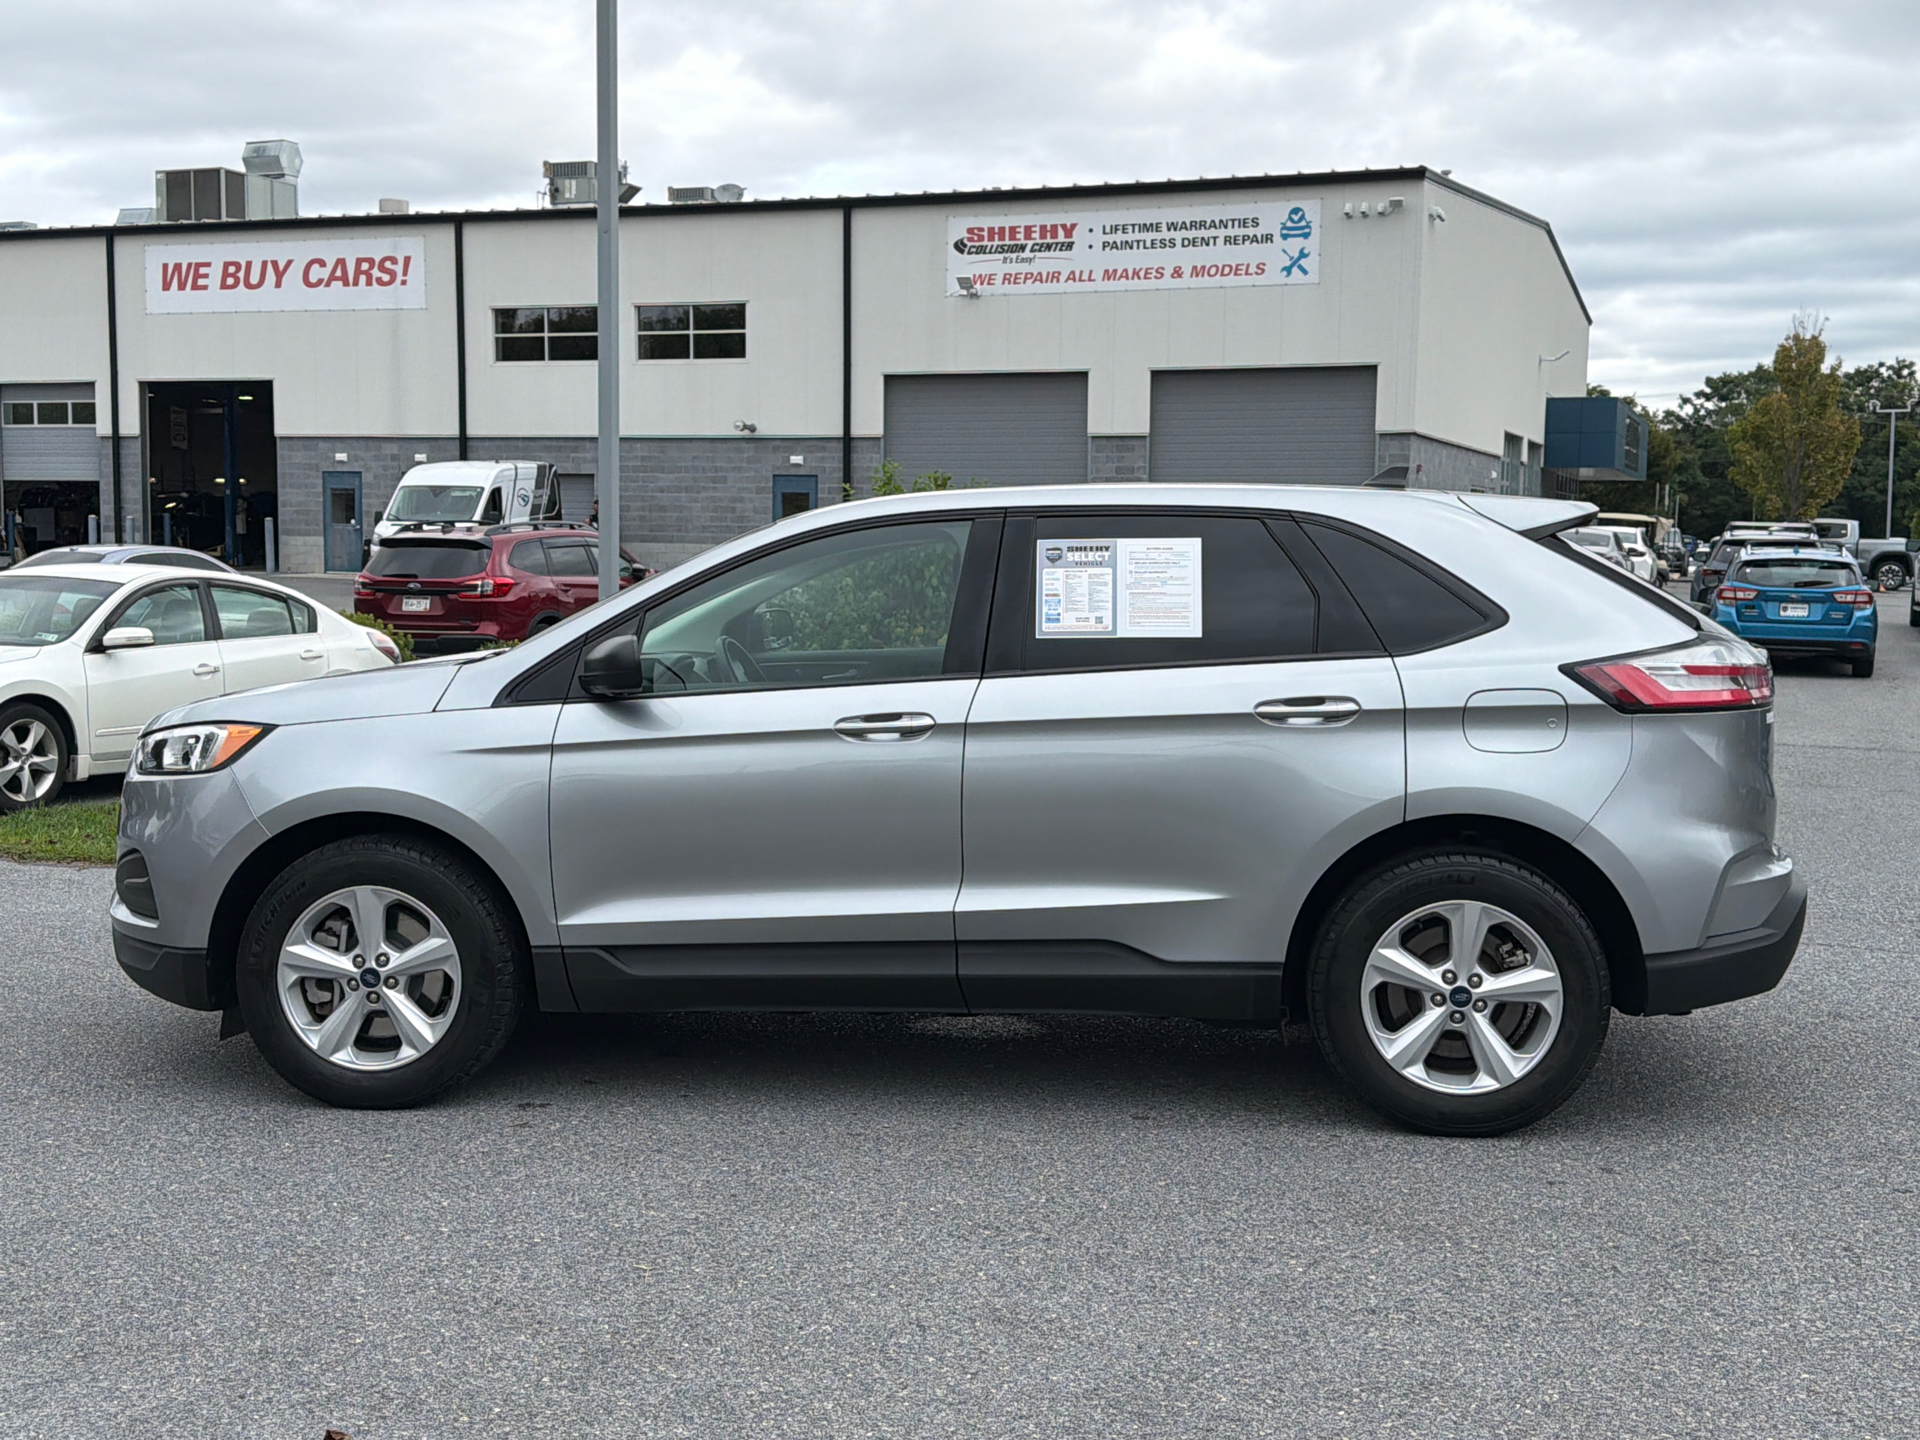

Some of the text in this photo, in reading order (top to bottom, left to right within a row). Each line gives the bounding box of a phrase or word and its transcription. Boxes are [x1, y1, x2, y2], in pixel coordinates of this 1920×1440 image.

[966, 223, 1078, 243] SHEEHY
[1102, 217, 1260, 235] LIFETIME WARRANTIES
[966, 241, 1075, 255] COLLISION CENTER
[1102, 233, 1274, 251] PAINTLESS DENT REPAIR
[1002, 254, 1037, 265] It's Easy!
[161, 255, 412, 292] WE BUY CARS!
[972, 262, 1267, 286] WE REPAIR ALL MAKES & MODELS
[1066, 552, 1111, 561] SELECT
